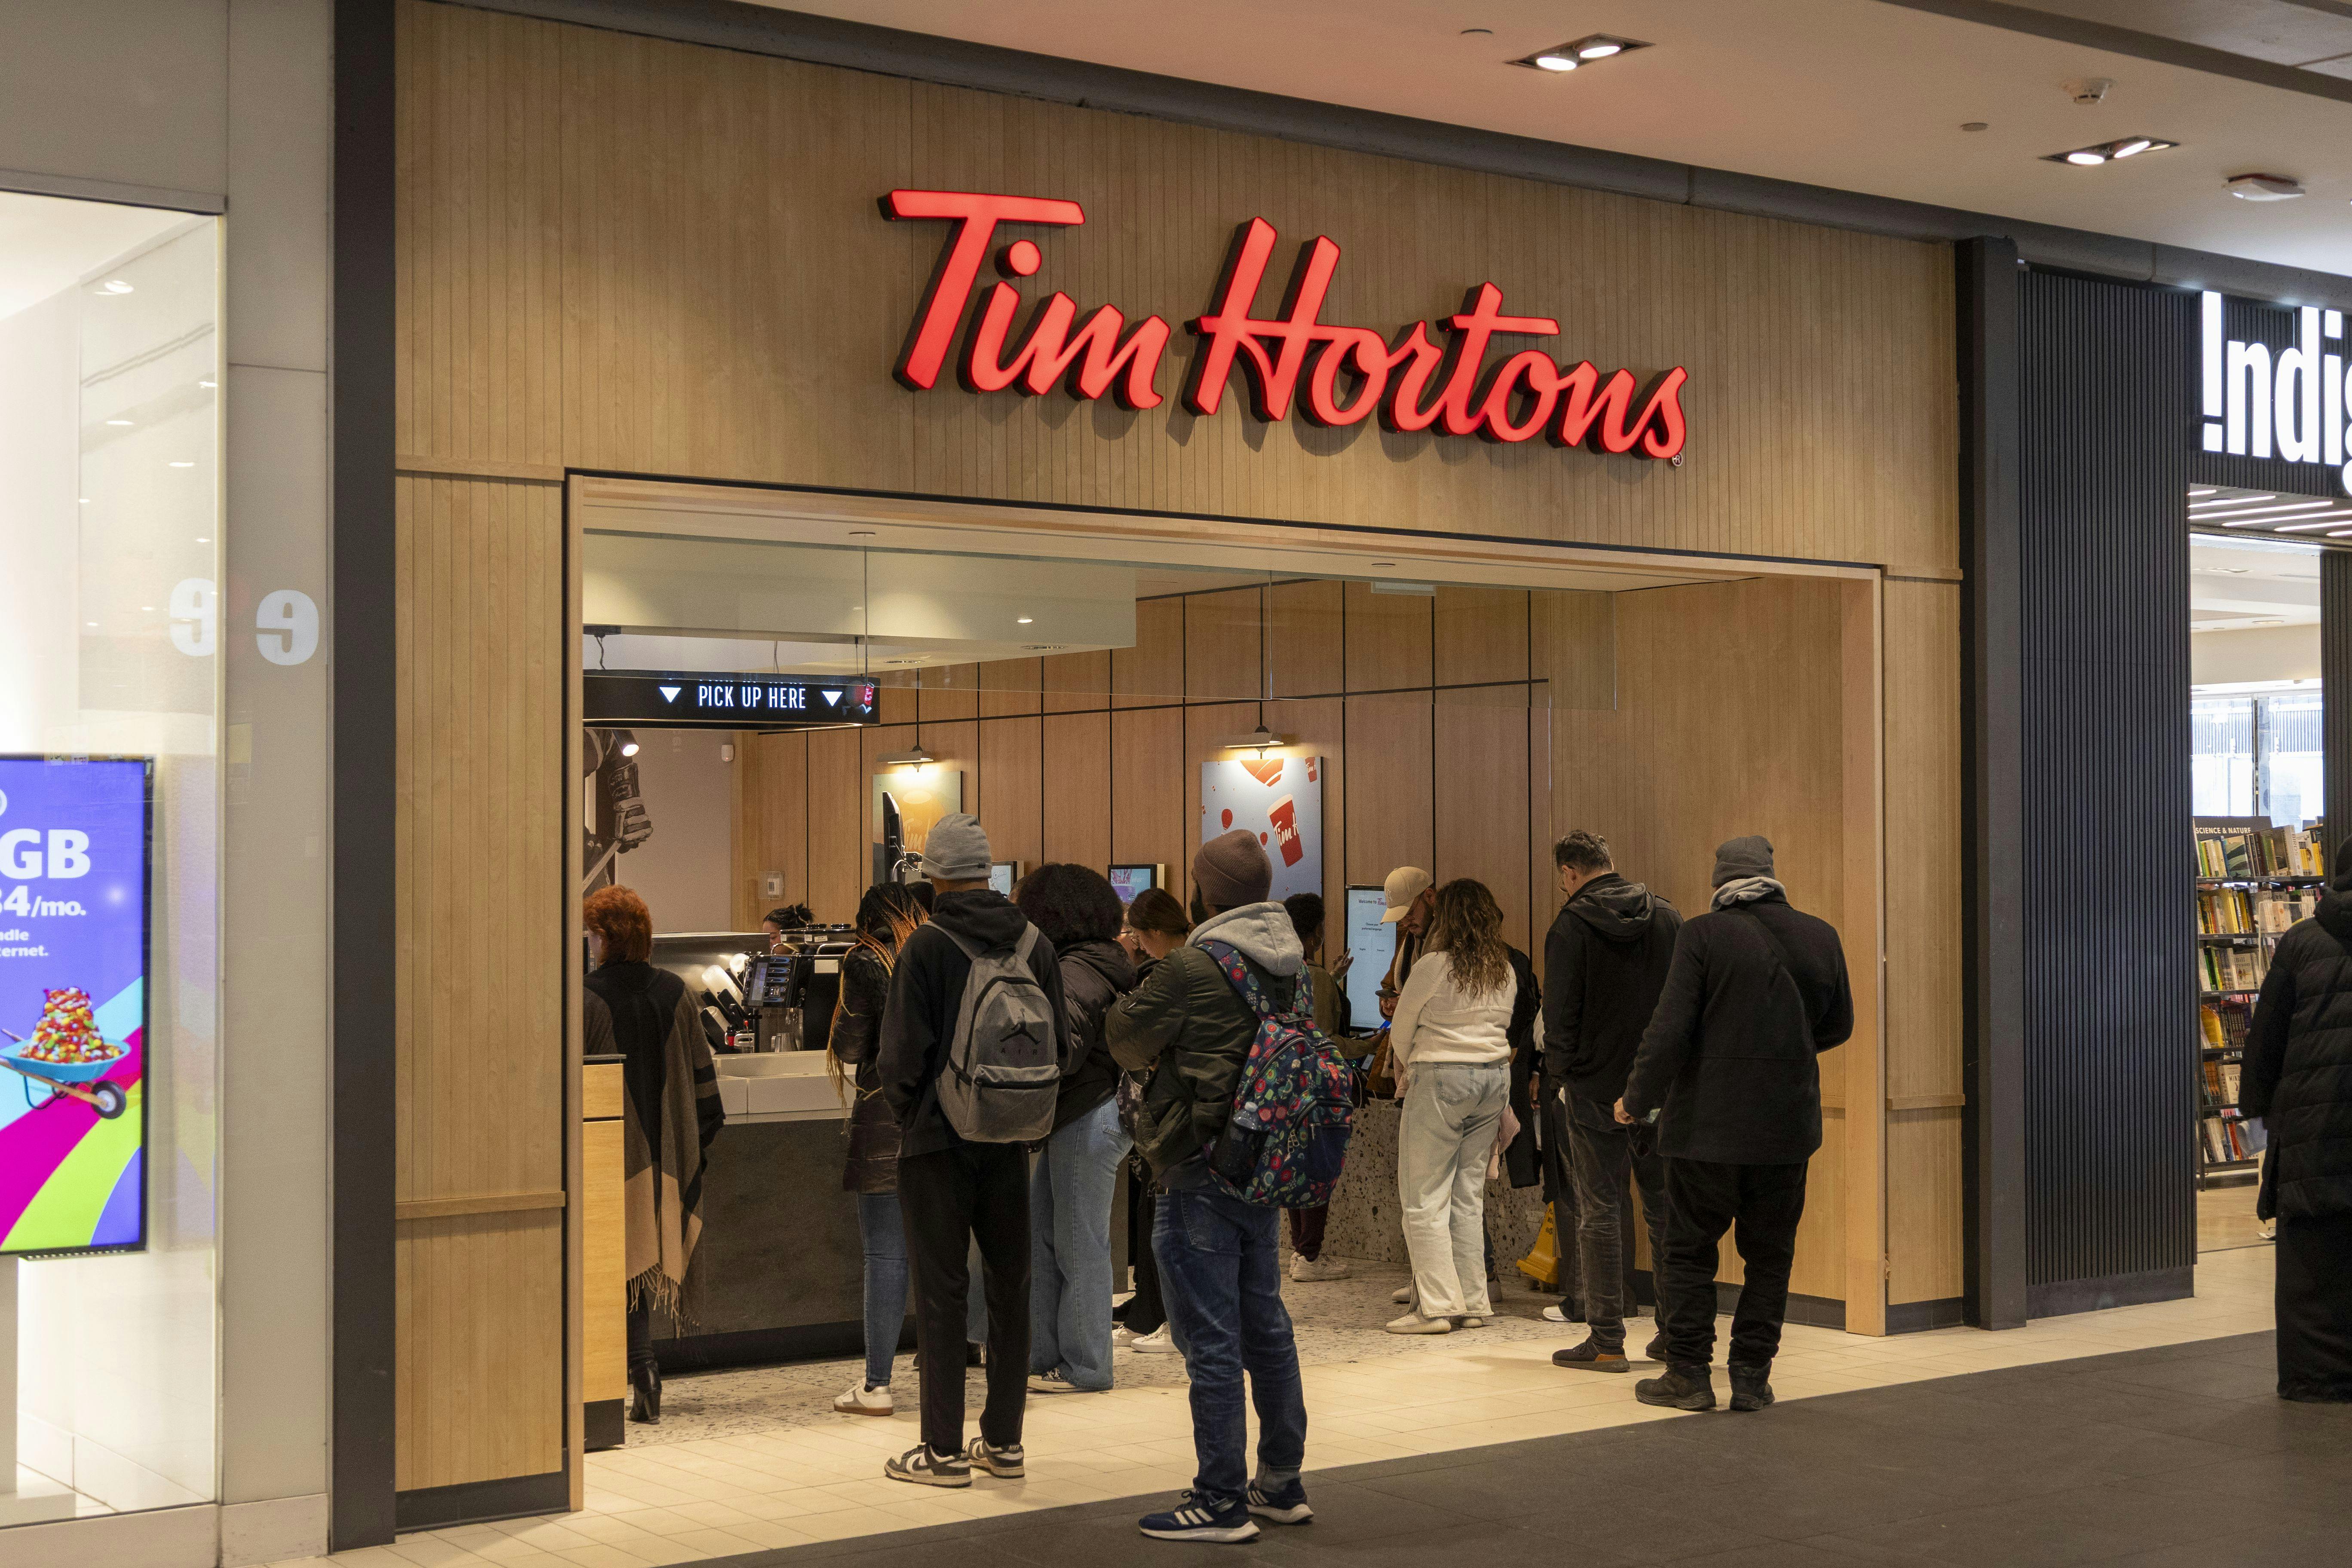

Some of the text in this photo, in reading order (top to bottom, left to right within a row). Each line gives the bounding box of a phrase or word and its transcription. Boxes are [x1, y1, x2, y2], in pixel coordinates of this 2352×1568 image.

[881, 189, 1171, 411] Tim
[1188, 216, 1688, 459] Hortons
[256, 589, 319, 666] 9
[698, 685, 806, 709] PICK UP HERE
[1274, 820, 1292, 846] Tim
[0, 885, 86, 918] 4/mo.
[0, 945, 49, 957] ernet.
